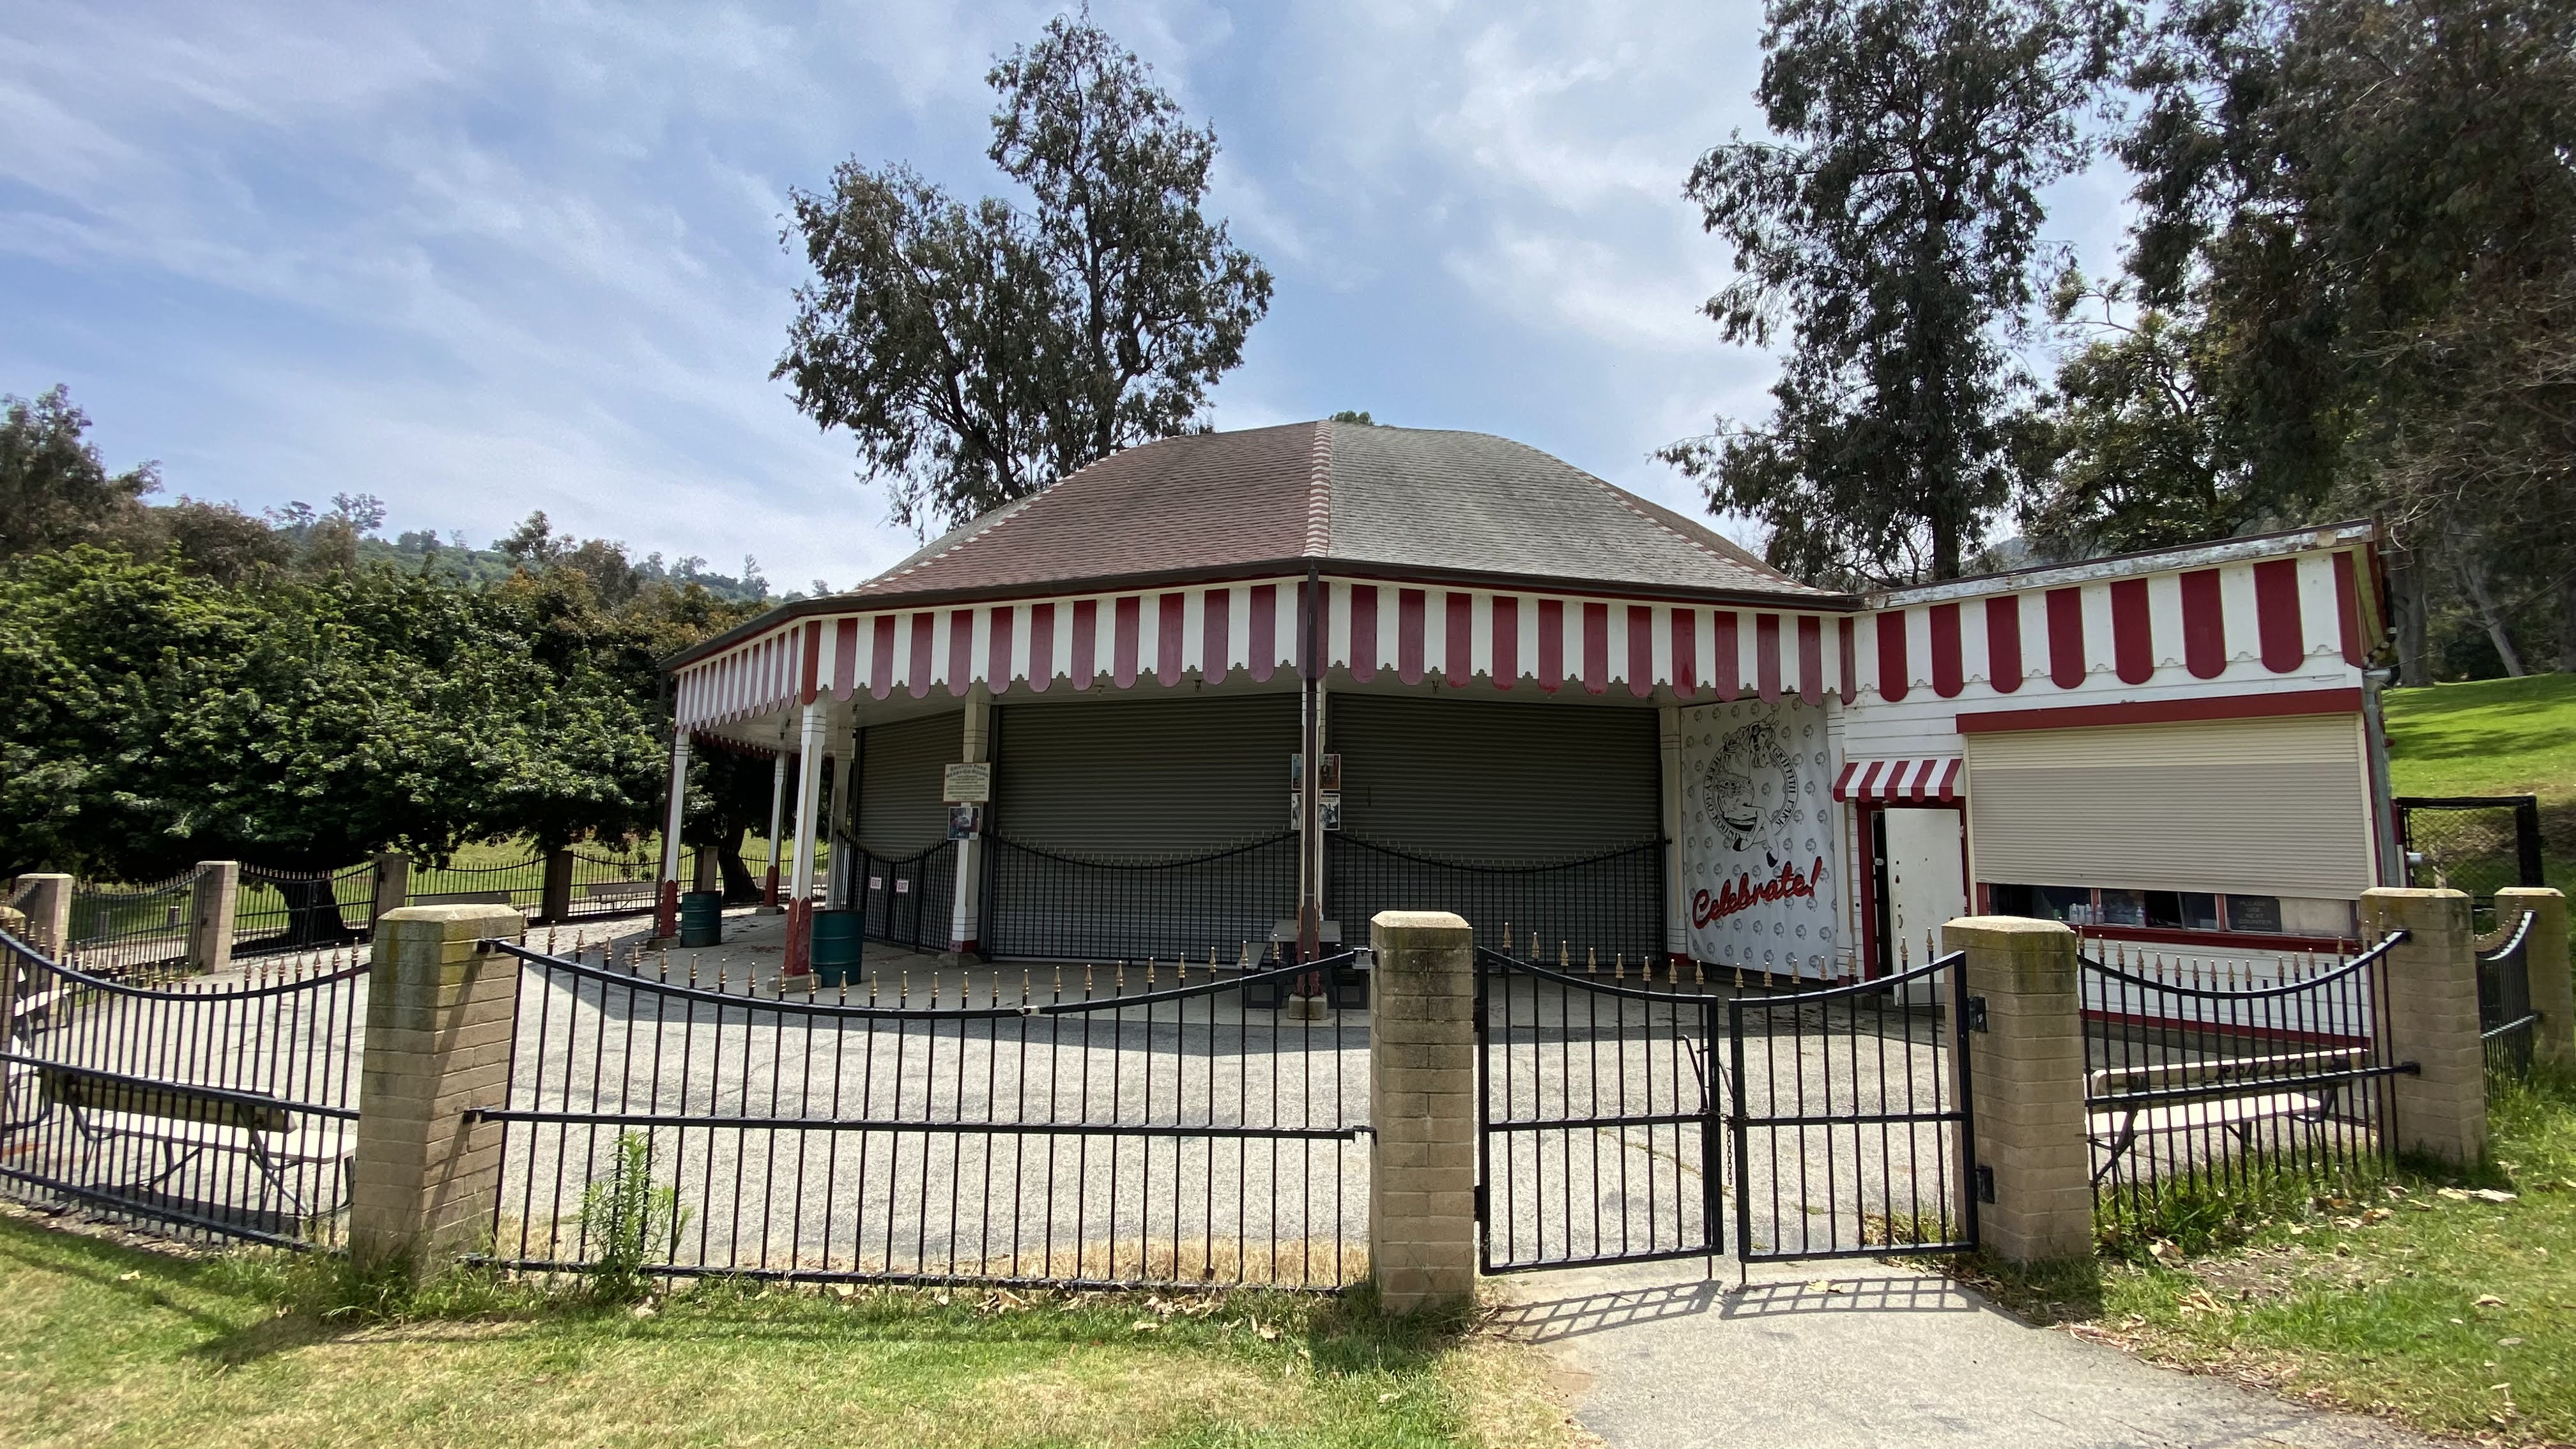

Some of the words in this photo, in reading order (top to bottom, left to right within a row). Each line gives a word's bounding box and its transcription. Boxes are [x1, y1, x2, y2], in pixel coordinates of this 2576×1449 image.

[1772, 747, 1796, 793] GRIFFITH
[1775, 799, 1795, 827] PARK
[1692, 856, 1823, 930] Celebrate!
